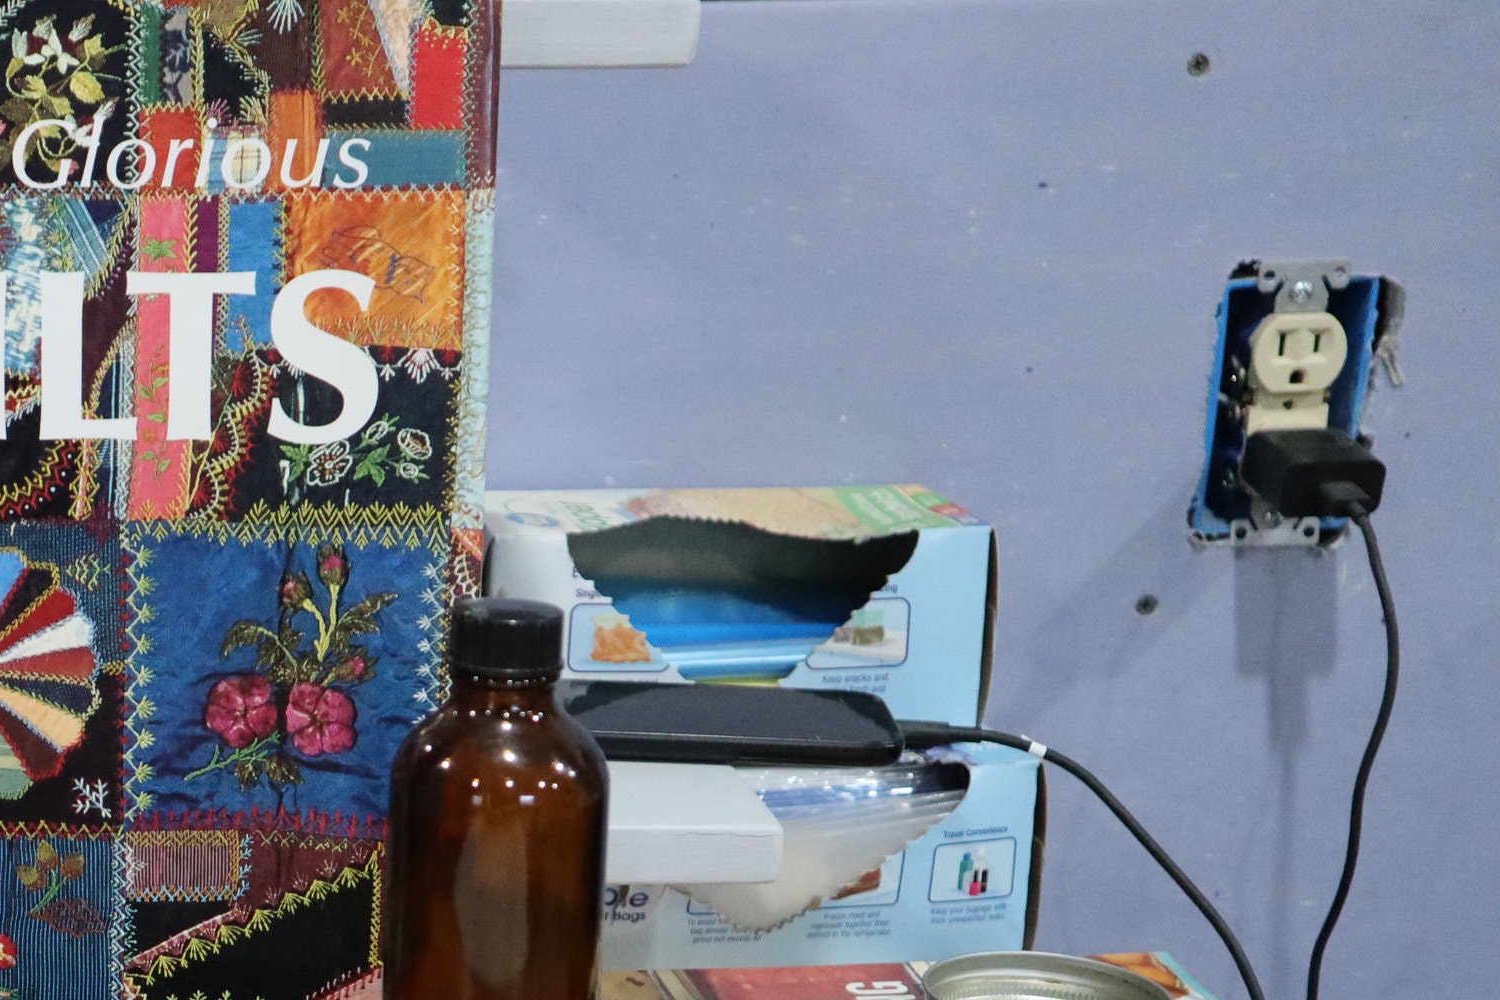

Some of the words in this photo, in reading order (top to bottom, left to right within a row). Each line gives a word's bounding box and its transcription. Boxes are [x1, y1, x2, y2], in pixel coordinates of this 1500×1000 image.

[12, 114, 373, 192] Glorious
[823, 675, 842, 684] Keep
[845, 673, 871, 682] snacks
[874, 672, 889, 681] and
[943, 830, 965, 839] Travel
[966, 826, 1008, 836] Convenience
